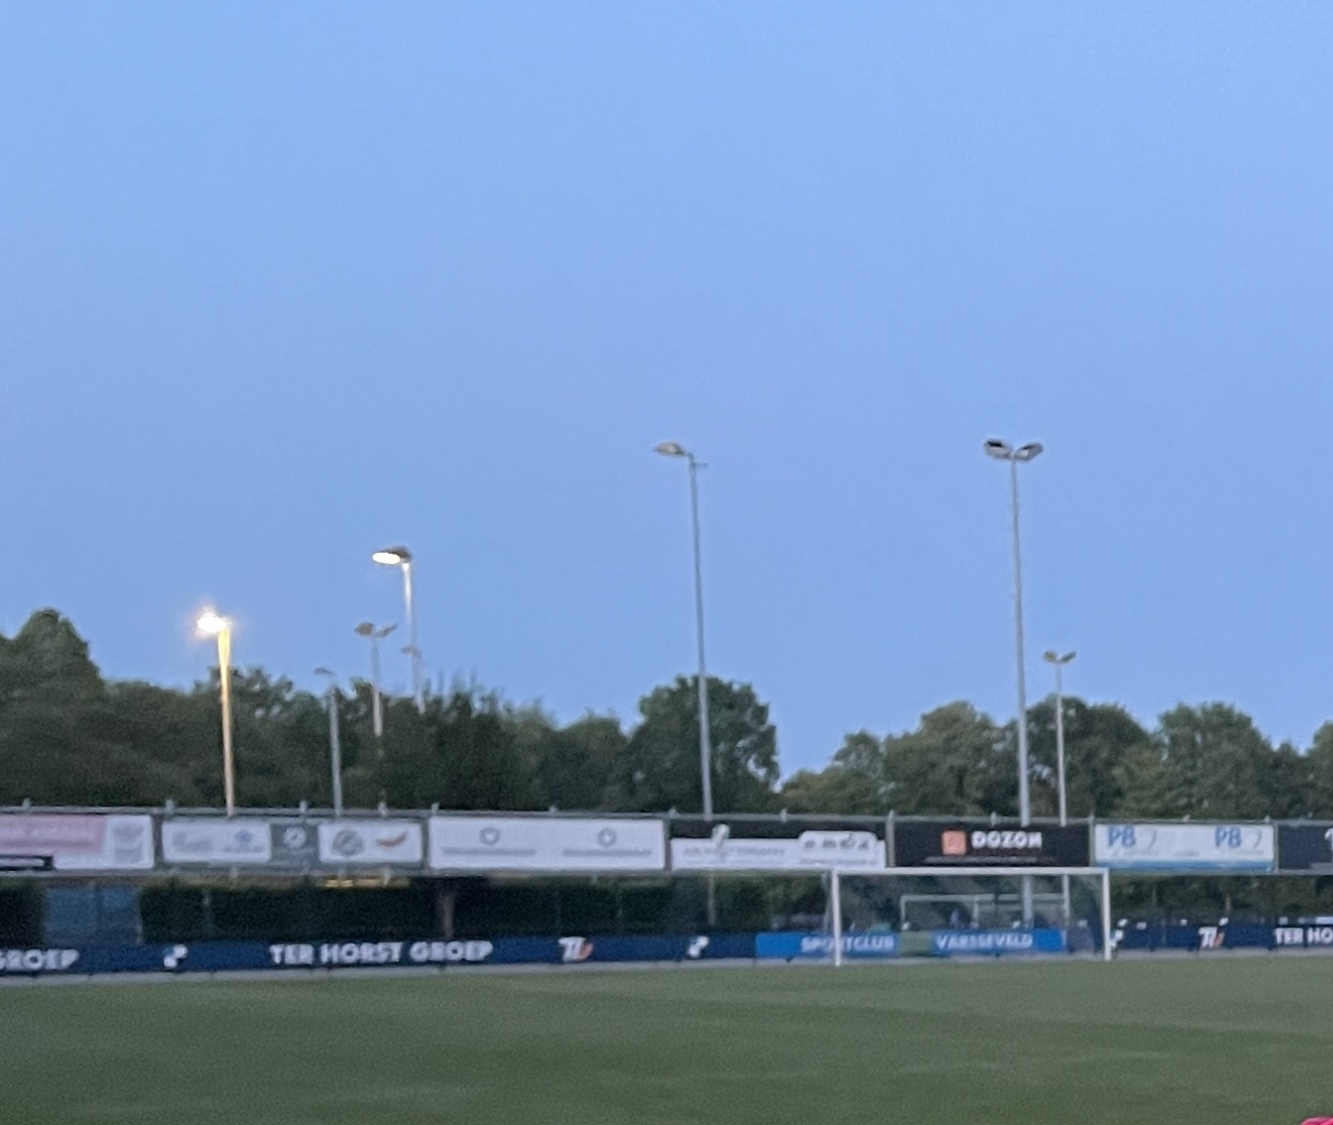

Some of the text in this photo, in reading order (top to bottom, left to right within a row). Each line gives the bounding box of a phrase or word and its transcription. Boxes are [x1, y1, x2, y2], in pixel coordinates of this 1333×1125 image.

[1275, 928, 1304, 944] TER
[270, 940, 494, 964] TER HORST GROEP
